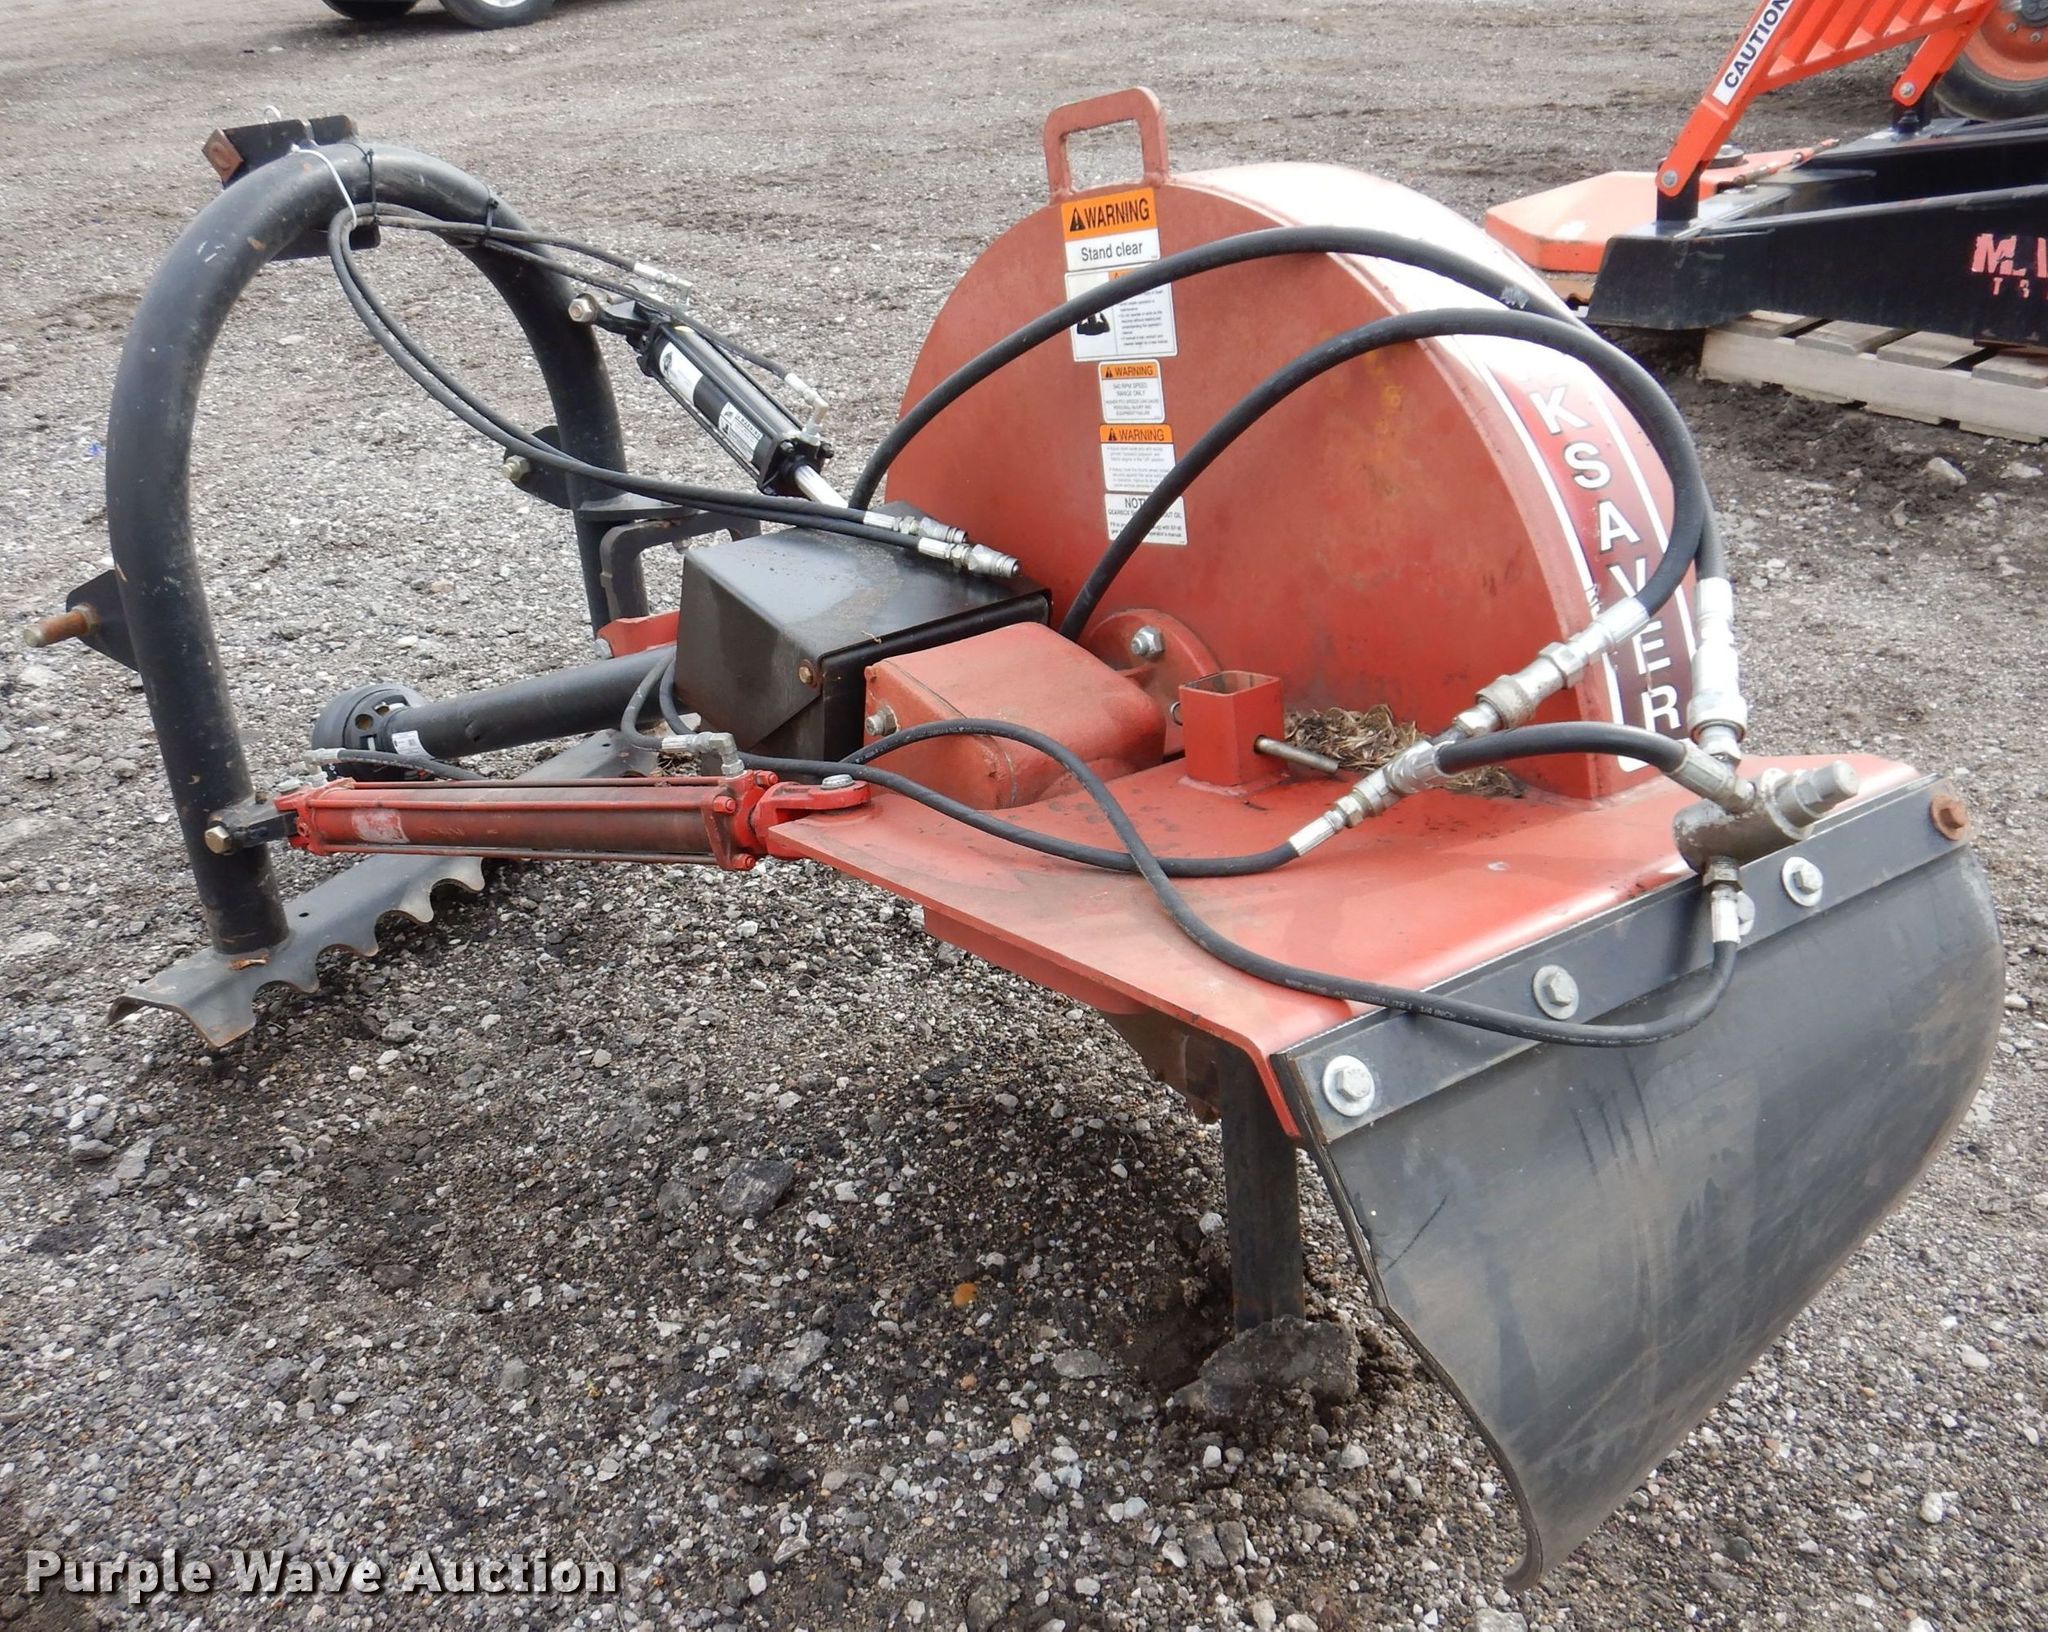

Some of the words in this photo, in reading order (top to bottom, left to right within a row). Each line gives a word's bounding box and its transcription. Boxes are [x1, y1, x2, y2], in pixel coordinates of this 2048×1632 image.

[1724, 0, 1790, 88] CAUTION
[1084, 198, 1150, 229] WARNING
[1081, 243, 1113, 262] Stand
[1116, 242, 1143, 257] clear
[1115, 365, 1153, 377] WARNING
[1119, 428, 1164, 441] WARNING
